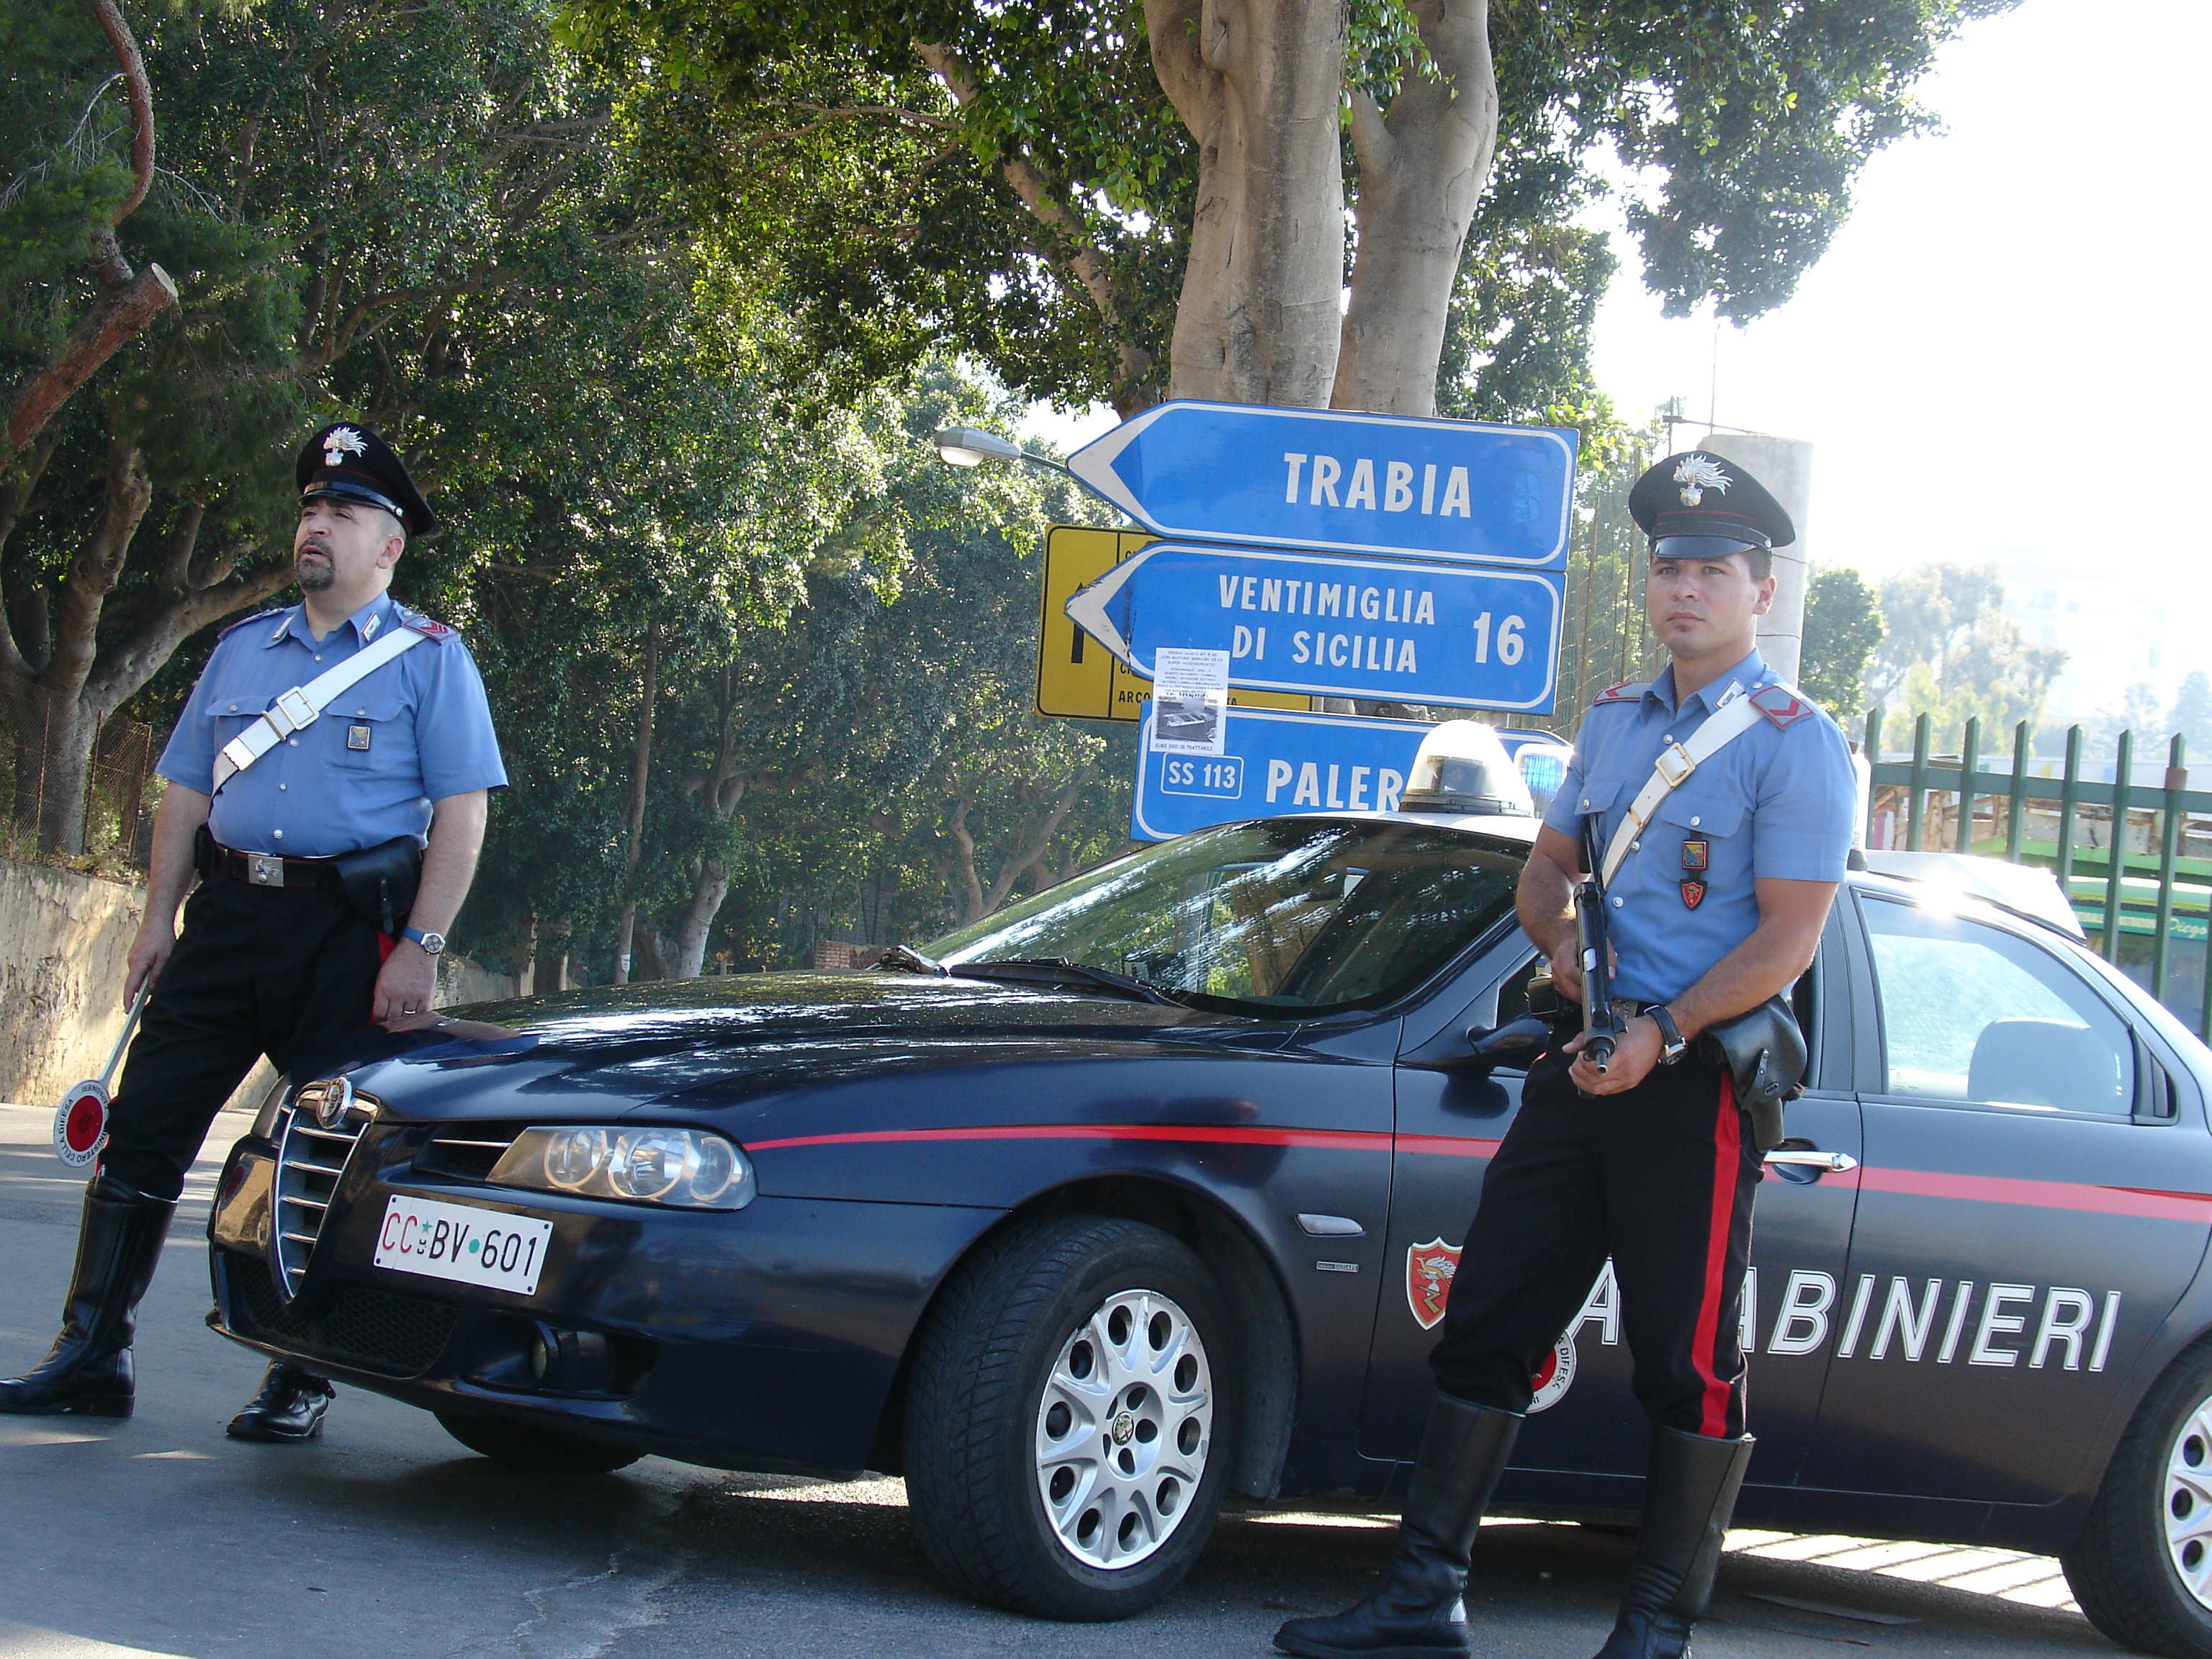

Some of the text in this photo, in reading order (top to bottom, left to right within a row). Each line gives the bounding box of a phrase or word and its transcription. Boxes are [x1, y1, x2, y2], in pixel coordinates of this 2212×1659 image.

[1284, 452, 1471, 518] TRABIA
[1219, 574, 1435, 625] VENTIMIGLIA
[1232, 625, 1416, 673] DI SICILIA
[1473, 611, 1526, 665] 16
[1169, 761, 1236, 788] SS 113
[1266, 759, 1403, 811] PALER
[2170, 917, 2207, 938] Diego
[76, 1130, 107, 1162] INISTERO
[382, 1212, 418, 1254] CC
[428, 1219, 469, 1263] BV
[481, 1229, 537, 1277] 601
[1567, 1254, 2121, 1372] AABINIERI
